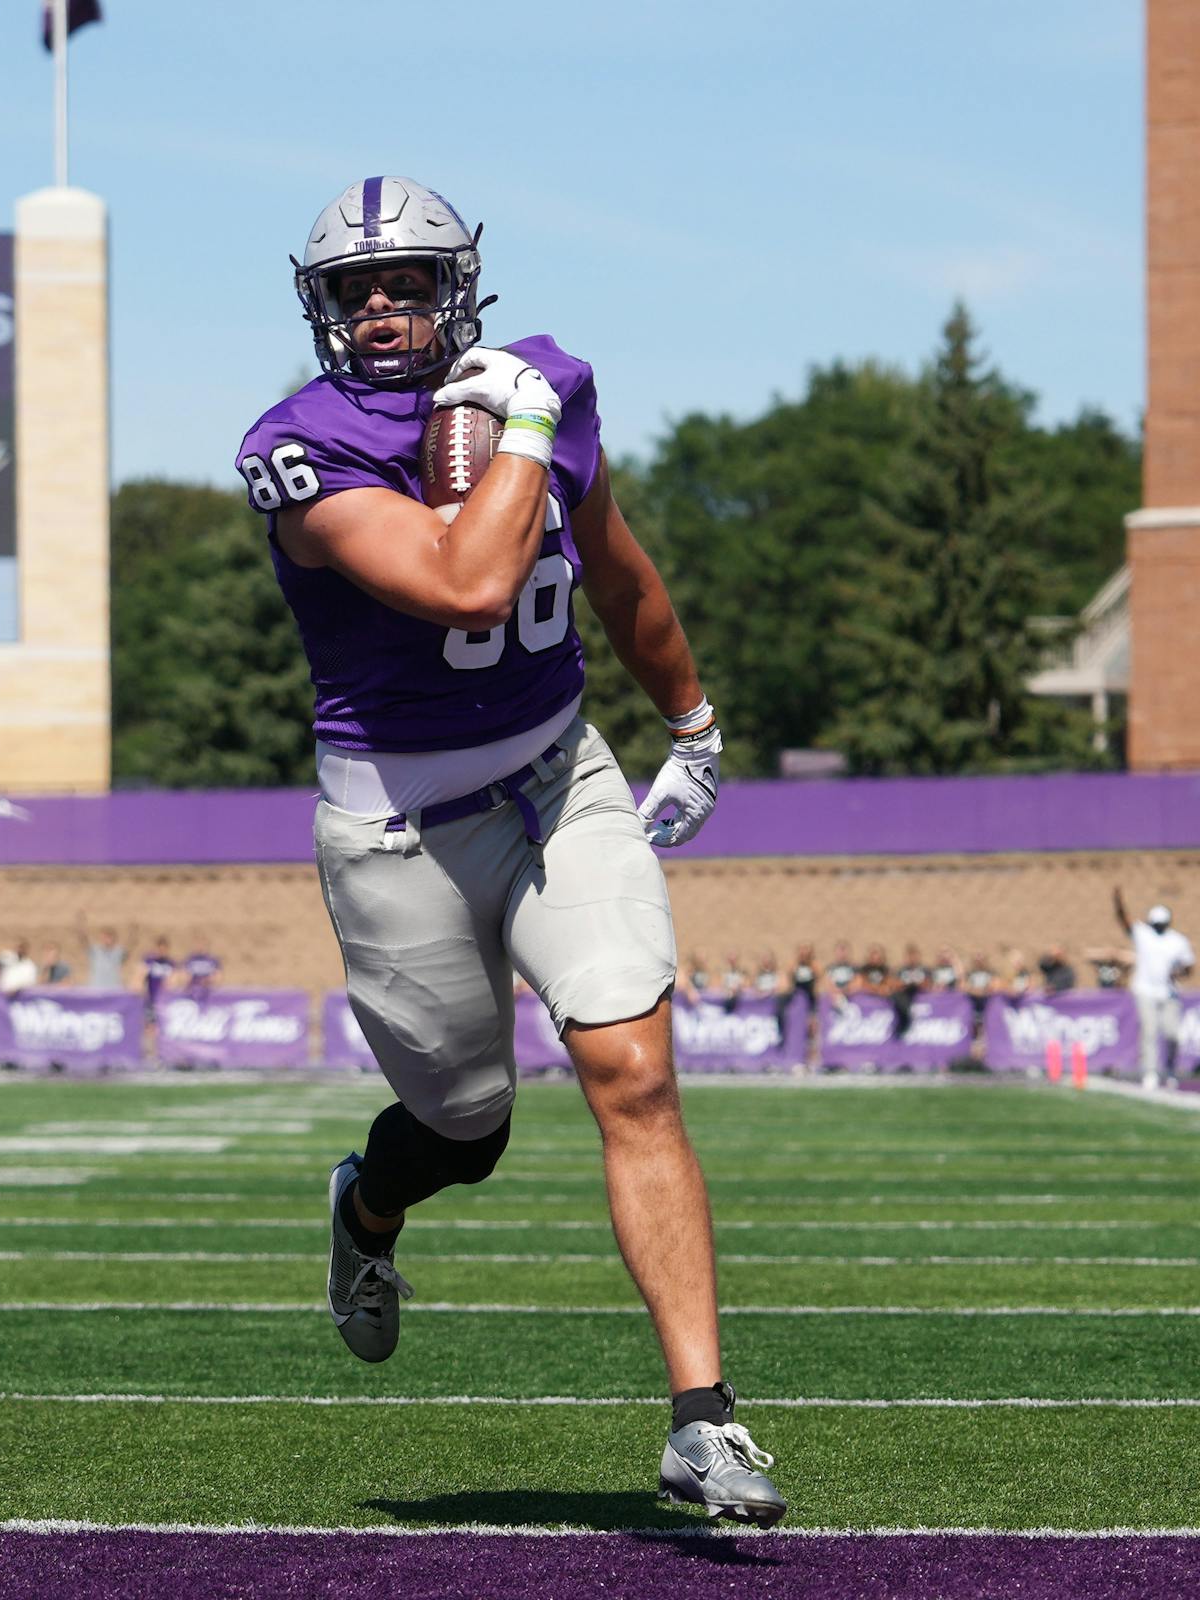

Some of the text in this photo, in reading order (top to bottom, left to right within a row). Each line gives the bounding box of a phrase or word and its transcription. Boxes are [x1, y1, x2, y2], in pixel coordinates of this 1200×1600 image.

[241, 443, 321, 511] 86
[10, 1000, 124, 1051] Wings
[1003, 1004, 1119, 1056] Wings
